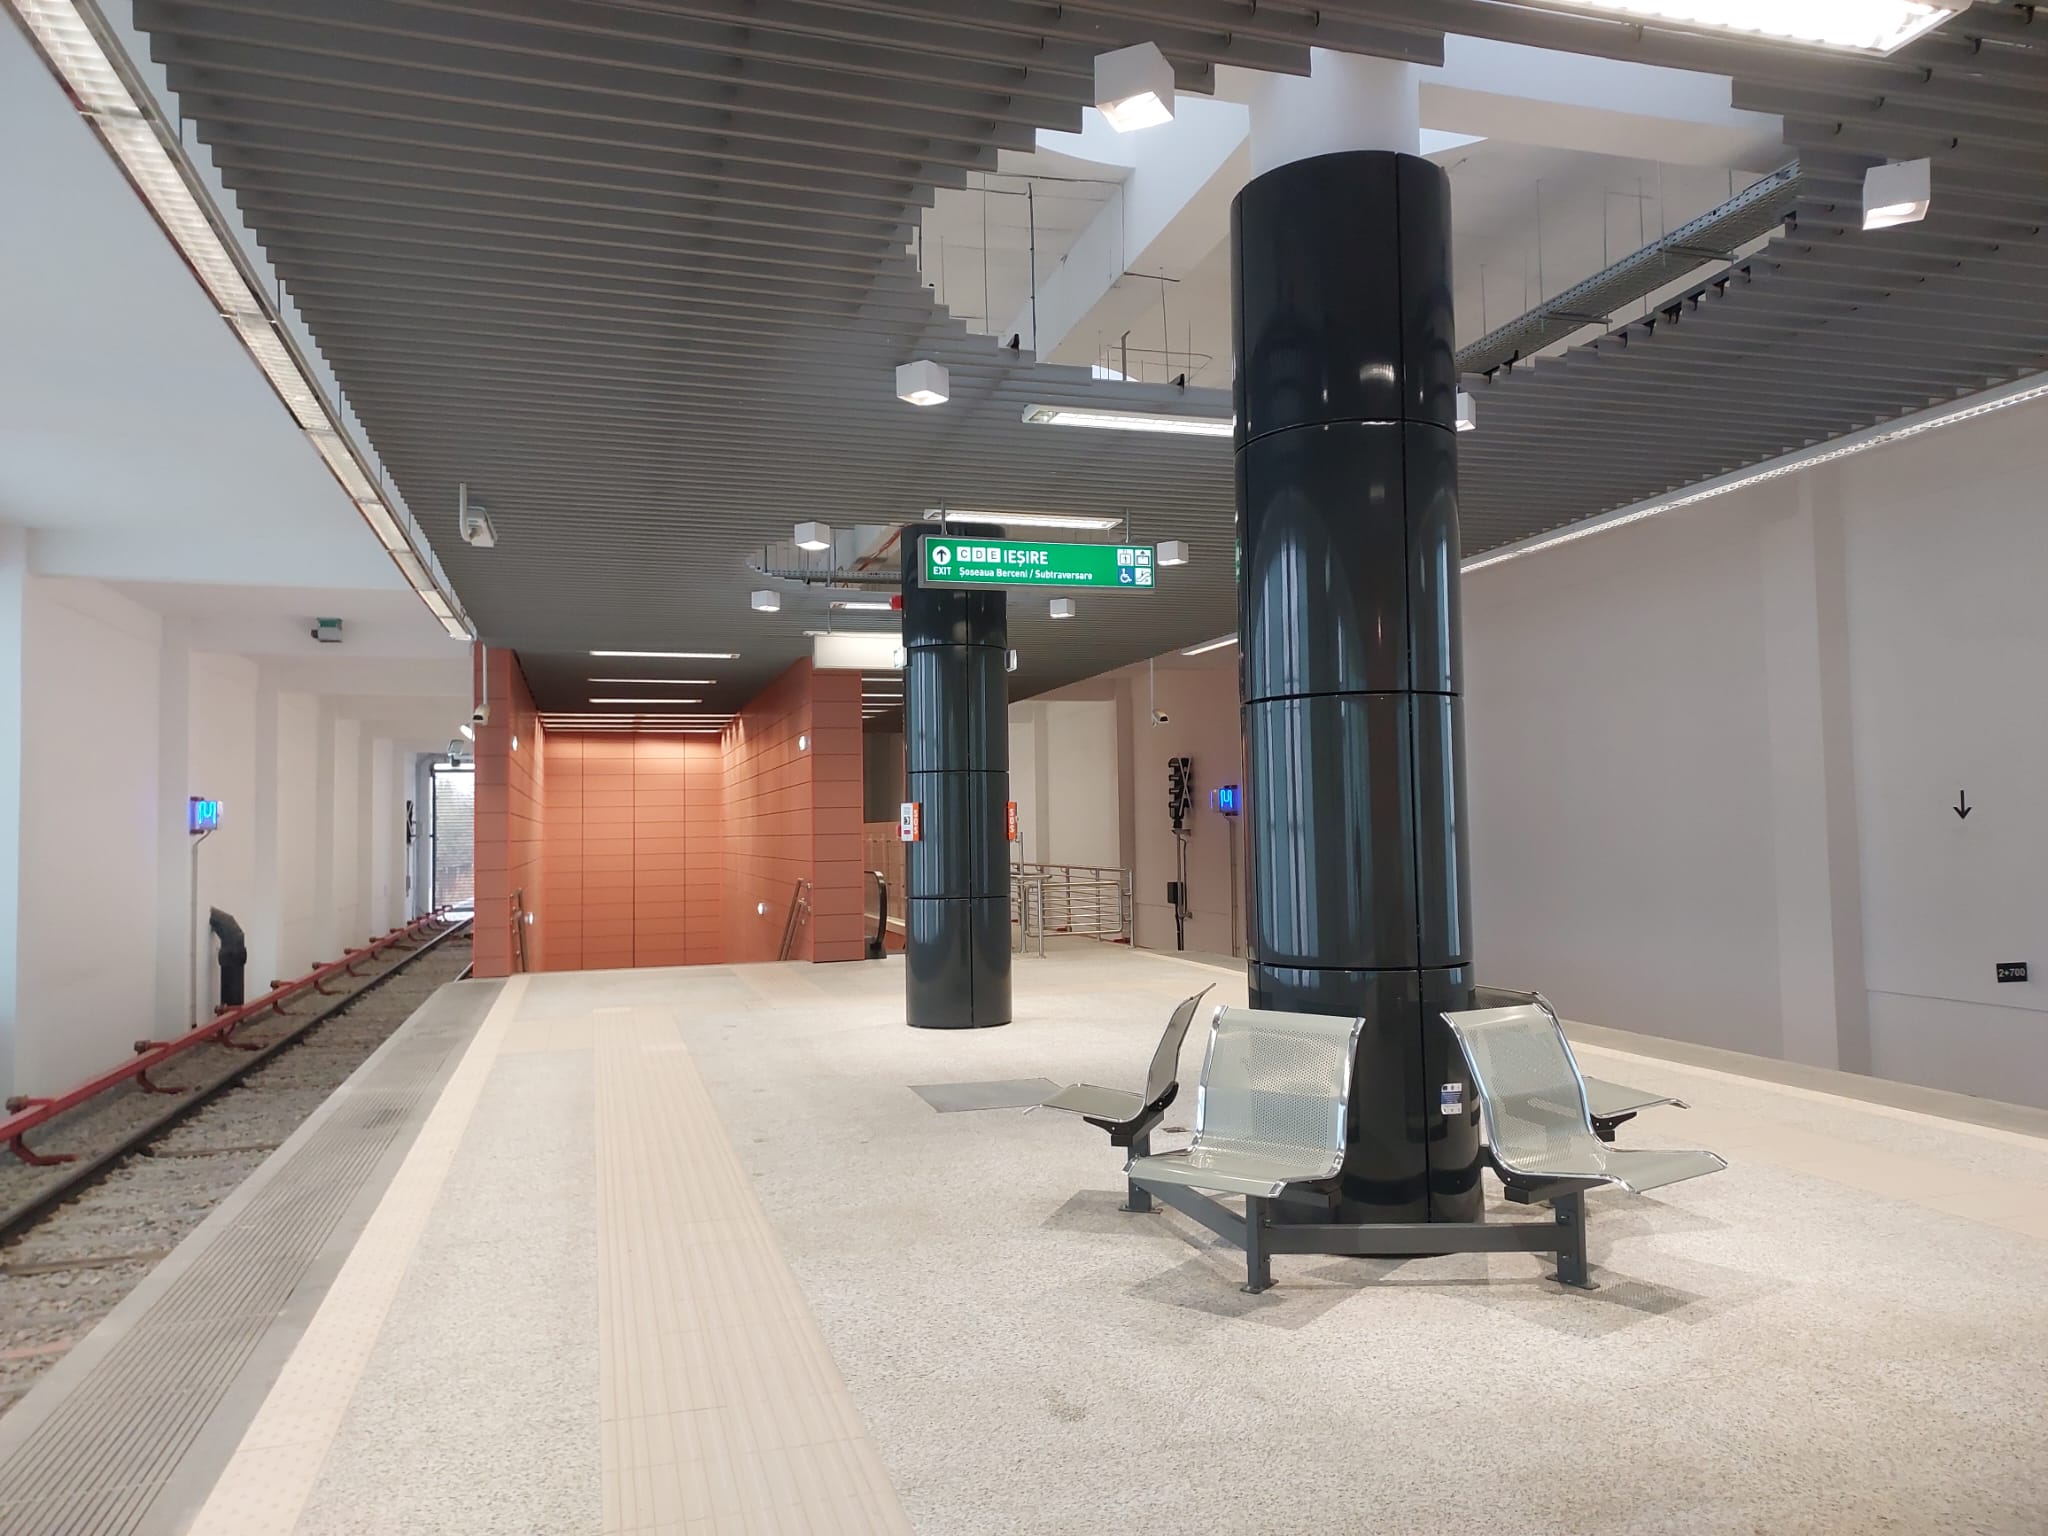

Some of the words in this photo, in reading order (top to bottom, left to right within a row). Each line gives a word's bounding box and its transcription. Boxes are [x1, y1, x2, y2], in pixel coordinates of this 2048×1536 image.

[1003, 549, 1049, 567] IEȘIRE
[932, 566, 952, 576] EXIT
[996, 568, 1028, 578] Berceni
[1034, 569, 1093, 580] Subtraversare
[1998, 967, 2026, 978] 2+700
